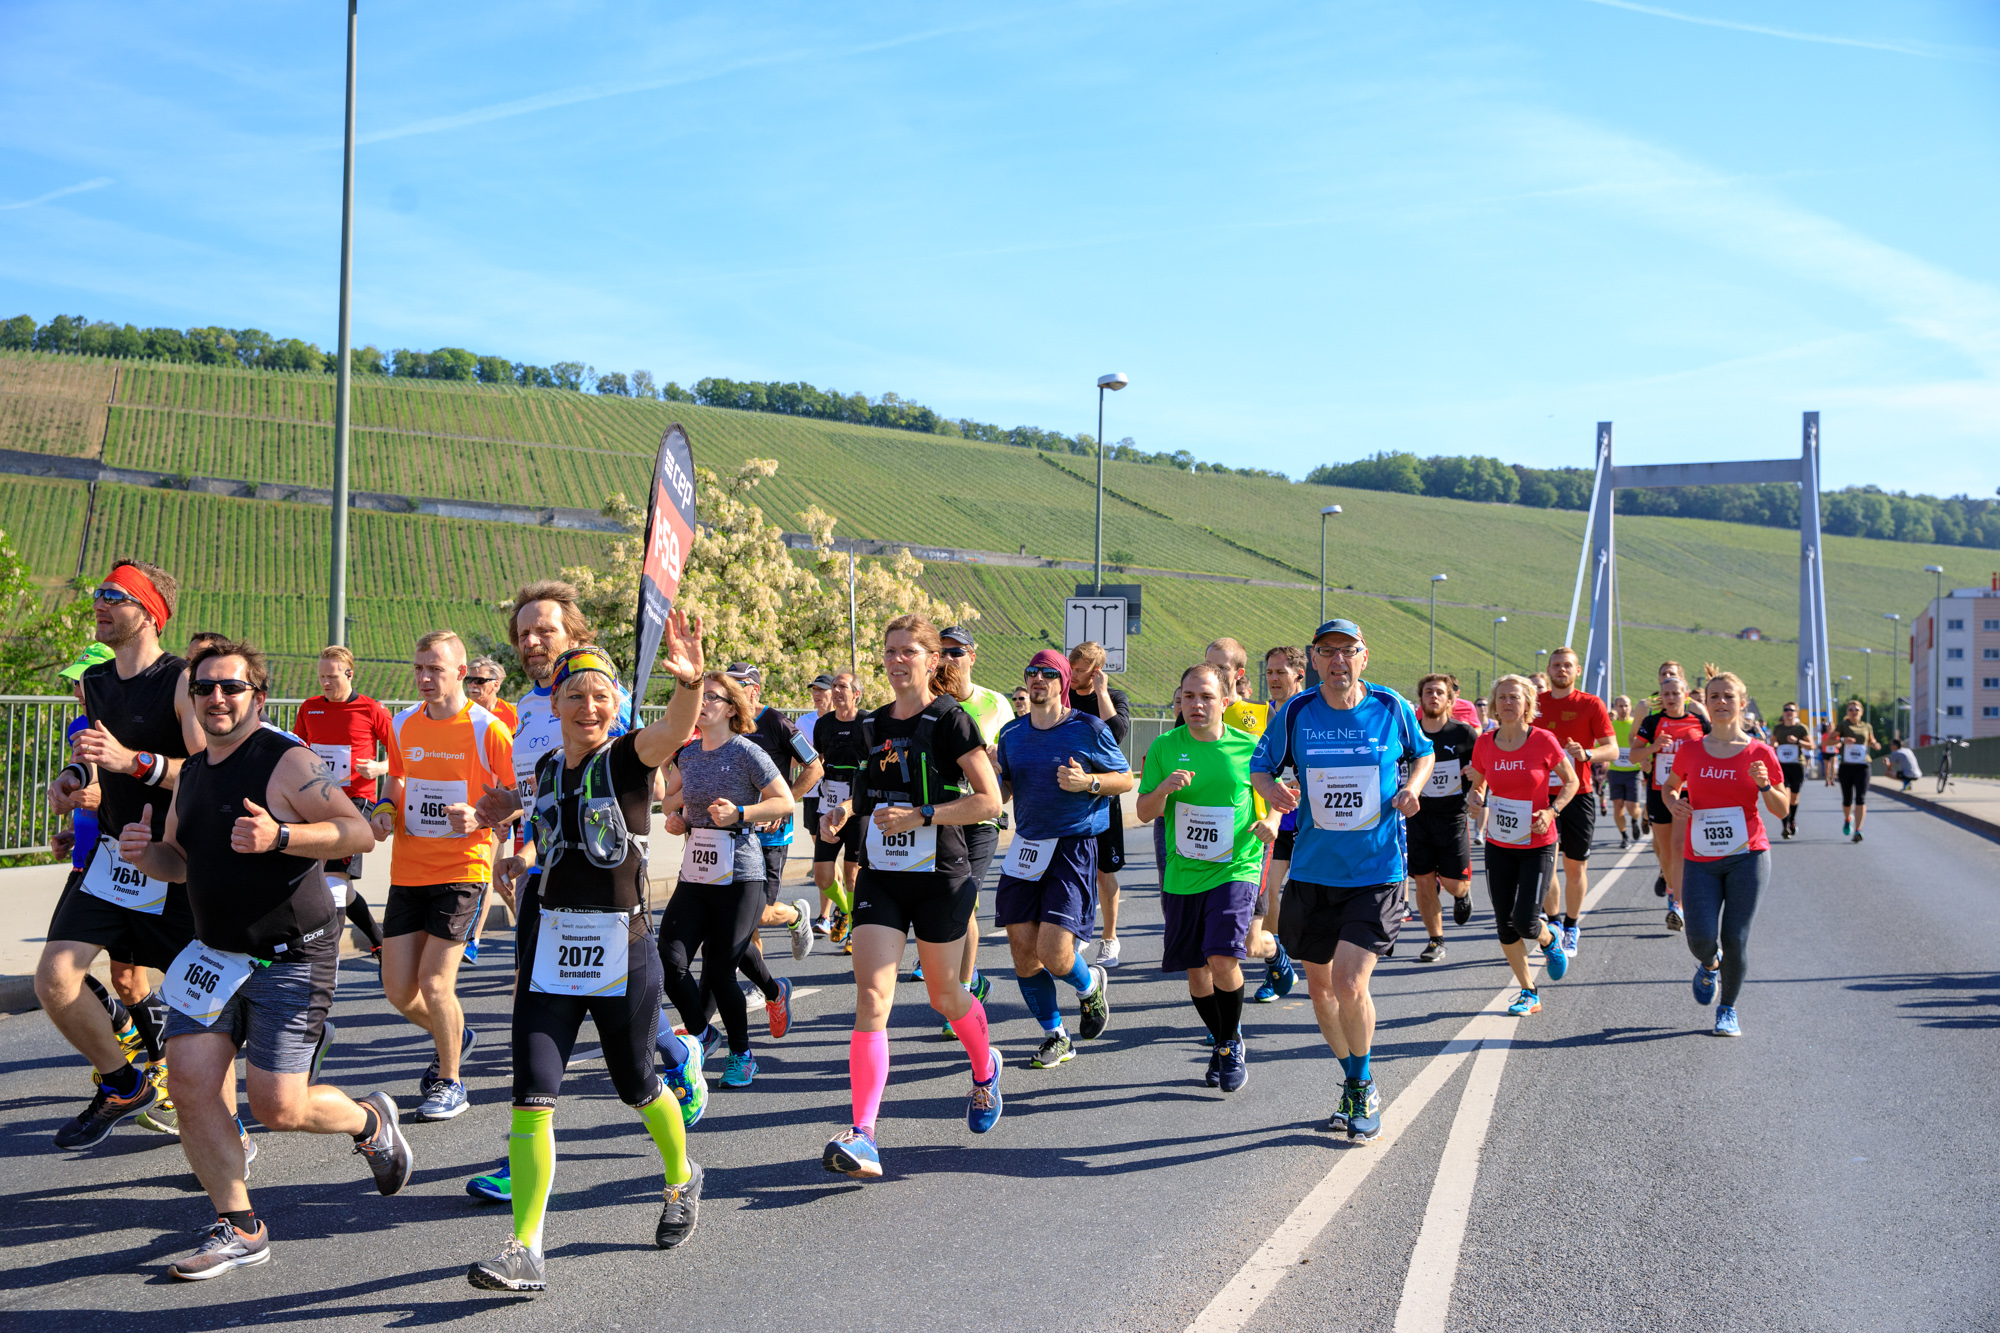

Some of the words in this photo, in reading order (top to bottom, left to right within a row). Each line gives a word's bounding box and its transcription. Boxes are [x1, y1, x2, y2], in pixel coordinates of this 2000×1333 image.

[672, 463, 694, 510] cep
[654, 504, 682, 583] 1:59
[1494, 758, 1526, 771] LÄUFT.
[1432, 774, 1449, 785] 327
[1700, 766, 1737, 781] LÄUFT.
[1323, 791, 1363, 808] 2225
[1335, 810, 1353, 818] Alfred
[1496, 814, 1519, 829] 1332
[420, 818, 447, 826] Aleksandr
[881, 829, 916, 847] 1651
[1186, 825, 1219, 843] 2276
[1703, 826, 1734, 840] 1333
[691, 849, 718, 865] 1249
[885, 849, 909, 857] Cordula
[1018, 848, 1038, 863] 1770
[112, 884, 140, 897] Thomas
[561, 934, 601, 942] Halbmarathon
[199, 954, 225, 971] Halbmarathon
[558, 945, 605, 968] 2072
[184, 962, 220, 994] 1646
[559, 970, 601, 979] Bernadette
[186, 987, 202, 1001] Frank
